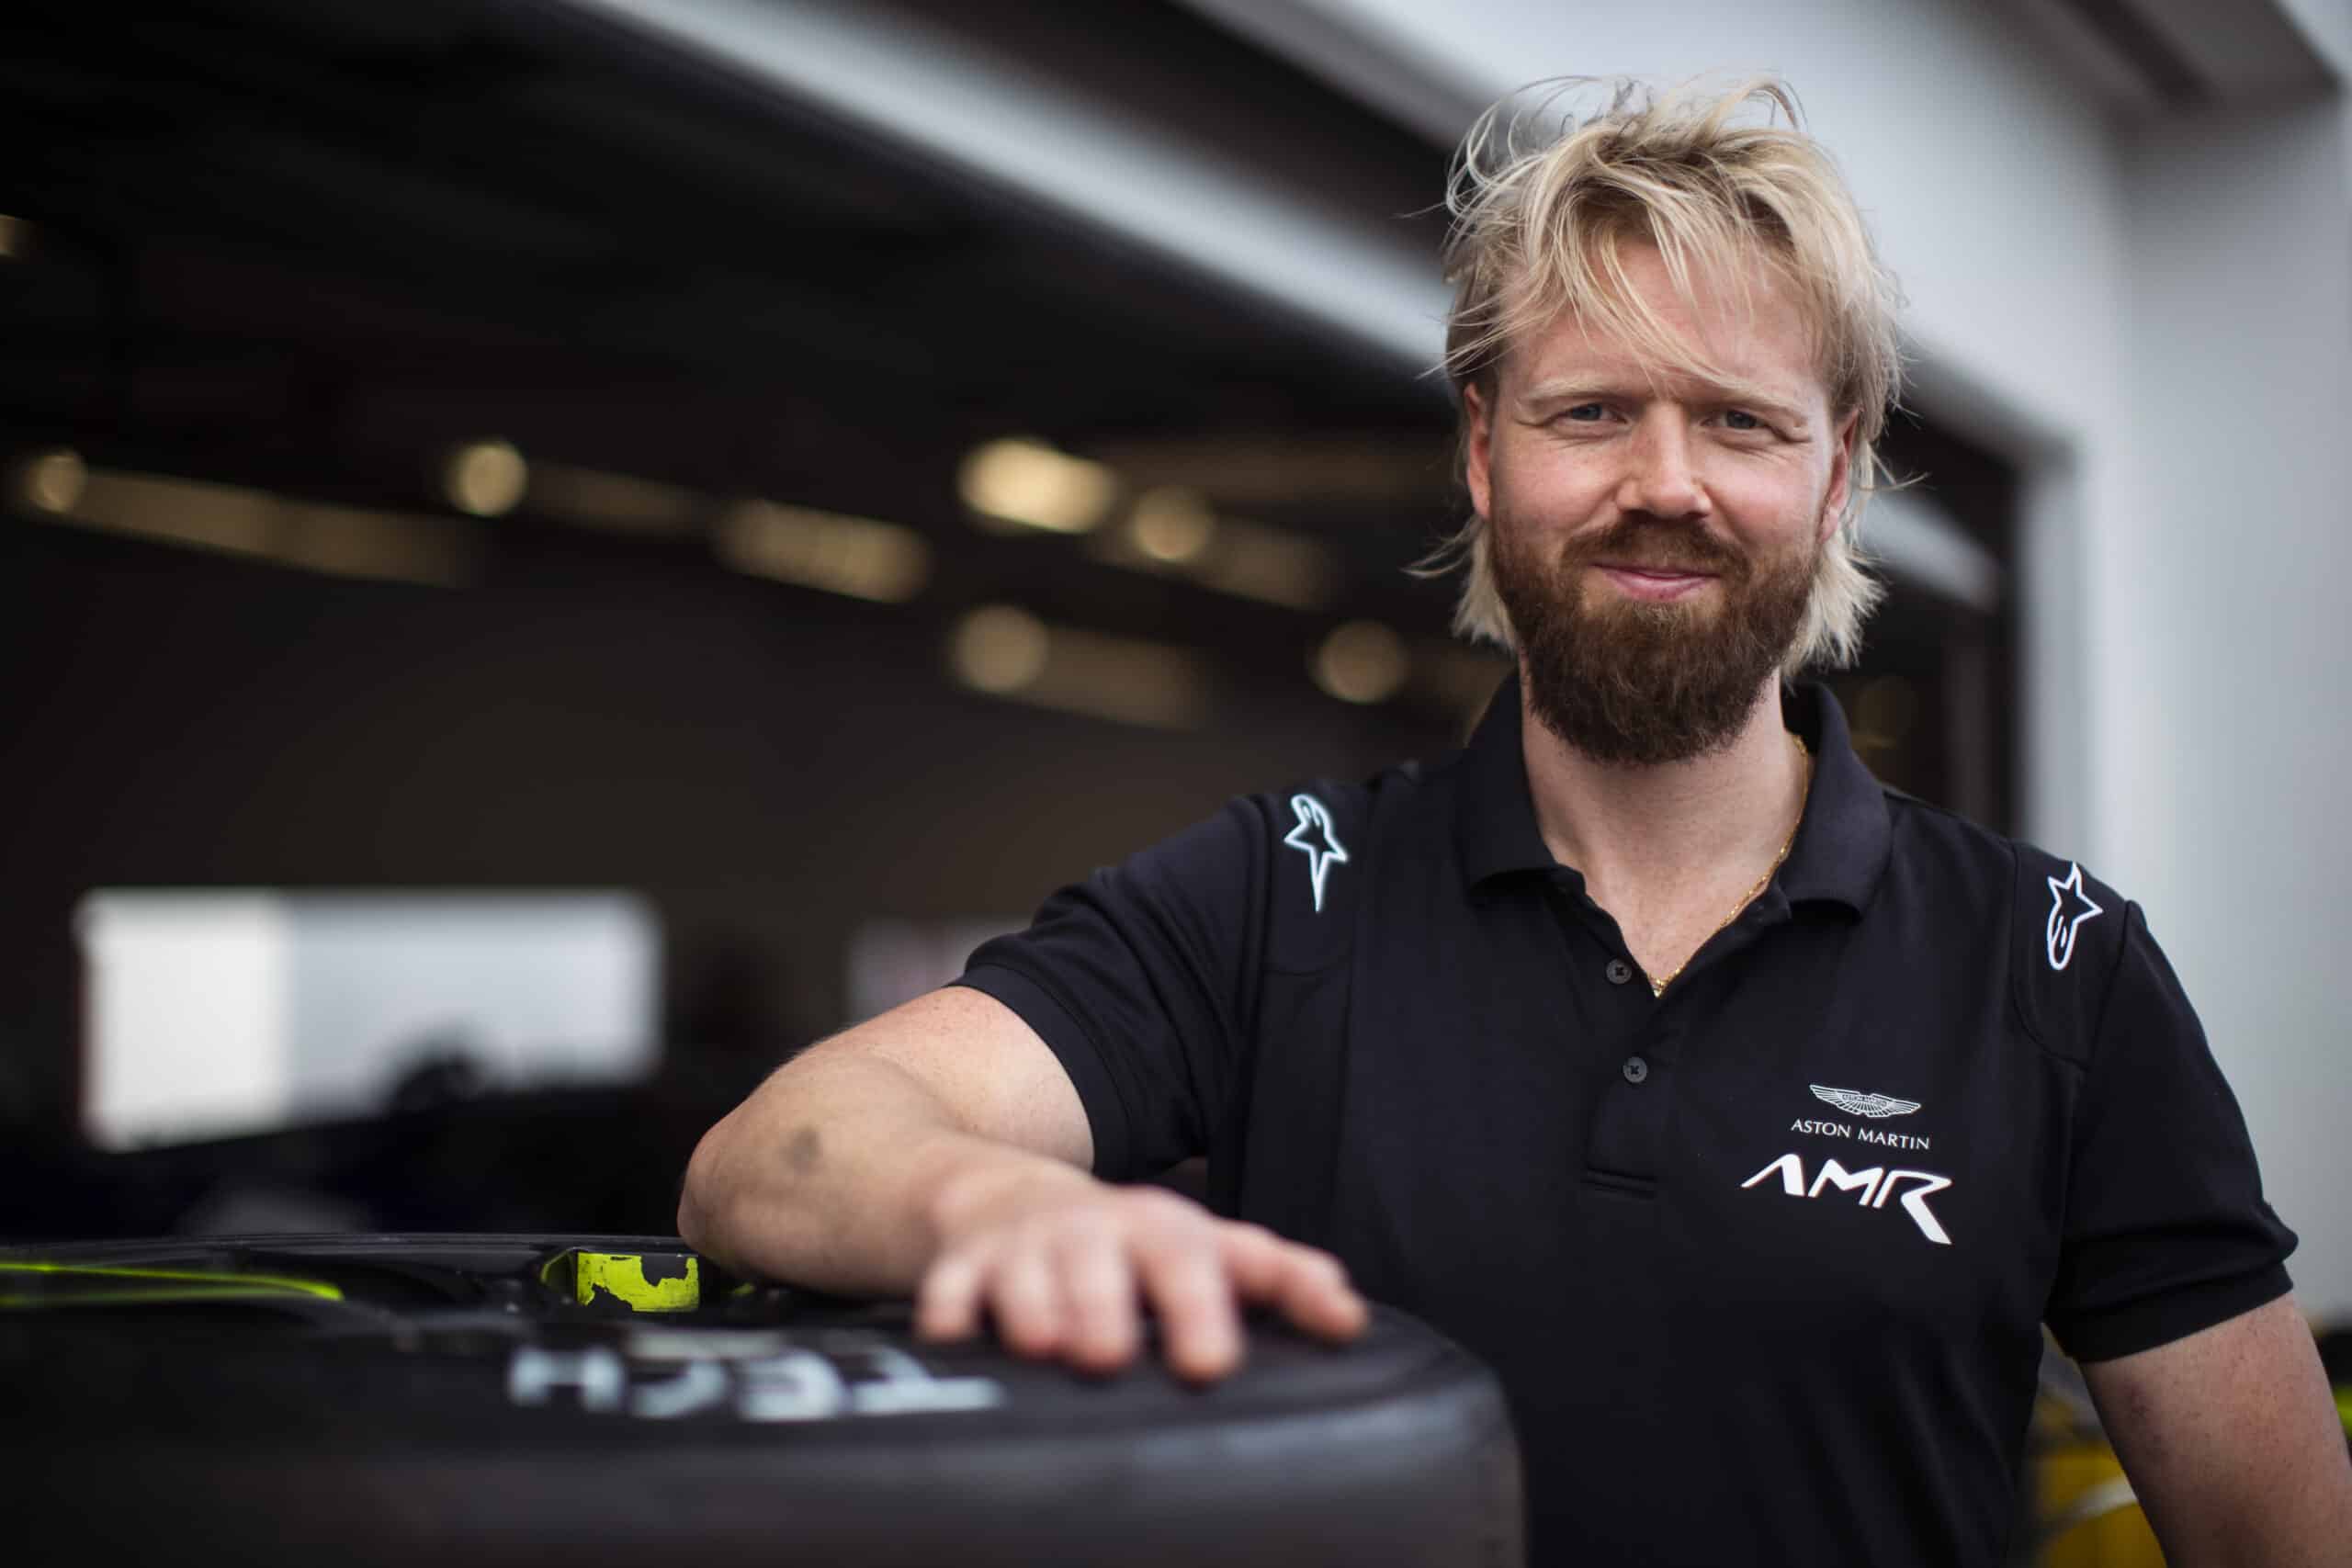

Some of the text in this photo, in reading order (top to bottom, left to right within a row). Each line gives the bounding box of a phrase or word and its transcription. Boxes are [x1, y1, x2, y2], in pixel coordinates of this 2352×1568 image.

[1791, 1118, 1930, 1150] ASTON MARTIN
[1740, 1153, 1952, 1245] AMR
